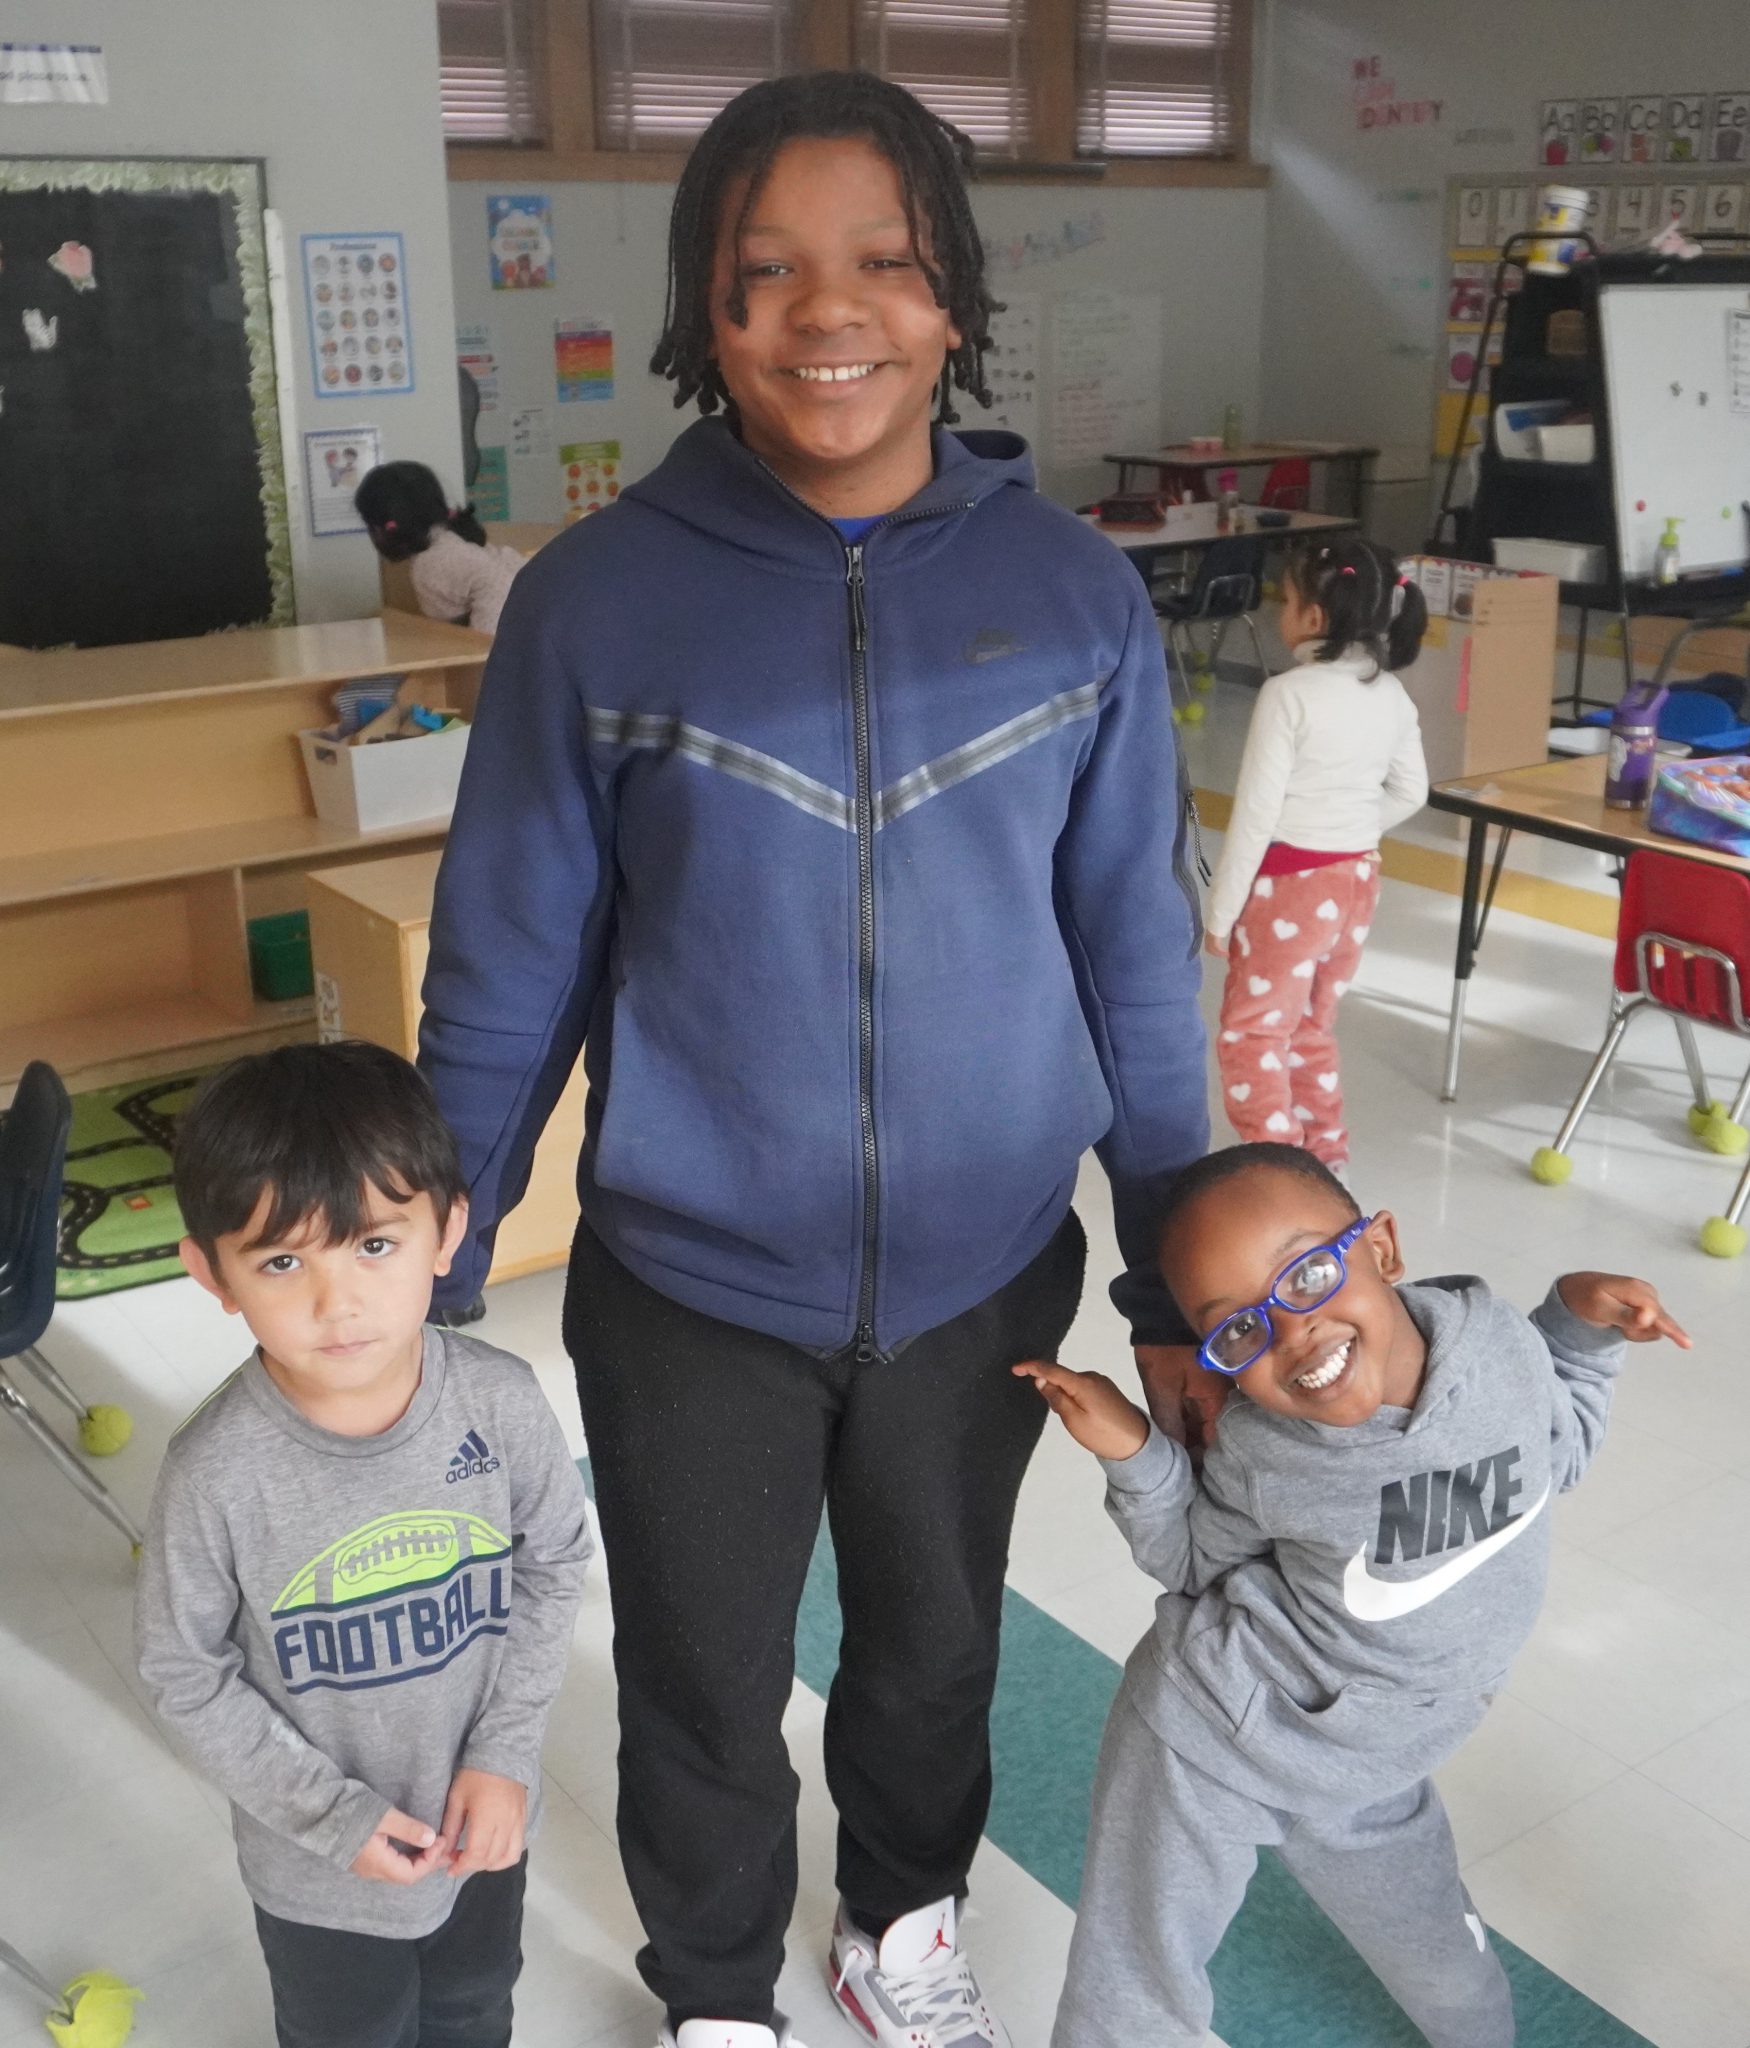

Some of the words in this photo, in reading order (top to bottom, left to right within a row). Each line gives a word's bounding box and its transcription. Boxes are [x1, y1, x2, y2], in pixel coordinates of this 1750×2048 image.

[1542, 107, 1576, 132] Aa
[1629, 104, 1658, 131] Cc
[1715, 98, 1748, 128] Ee
[1627, 189, 1641, 218] 4
[1714, 188, 1732, 218] 6
[1374, 1445, 1523, 1564] NIKE
[273, 1567, 510, 1680] FOOTBALL
